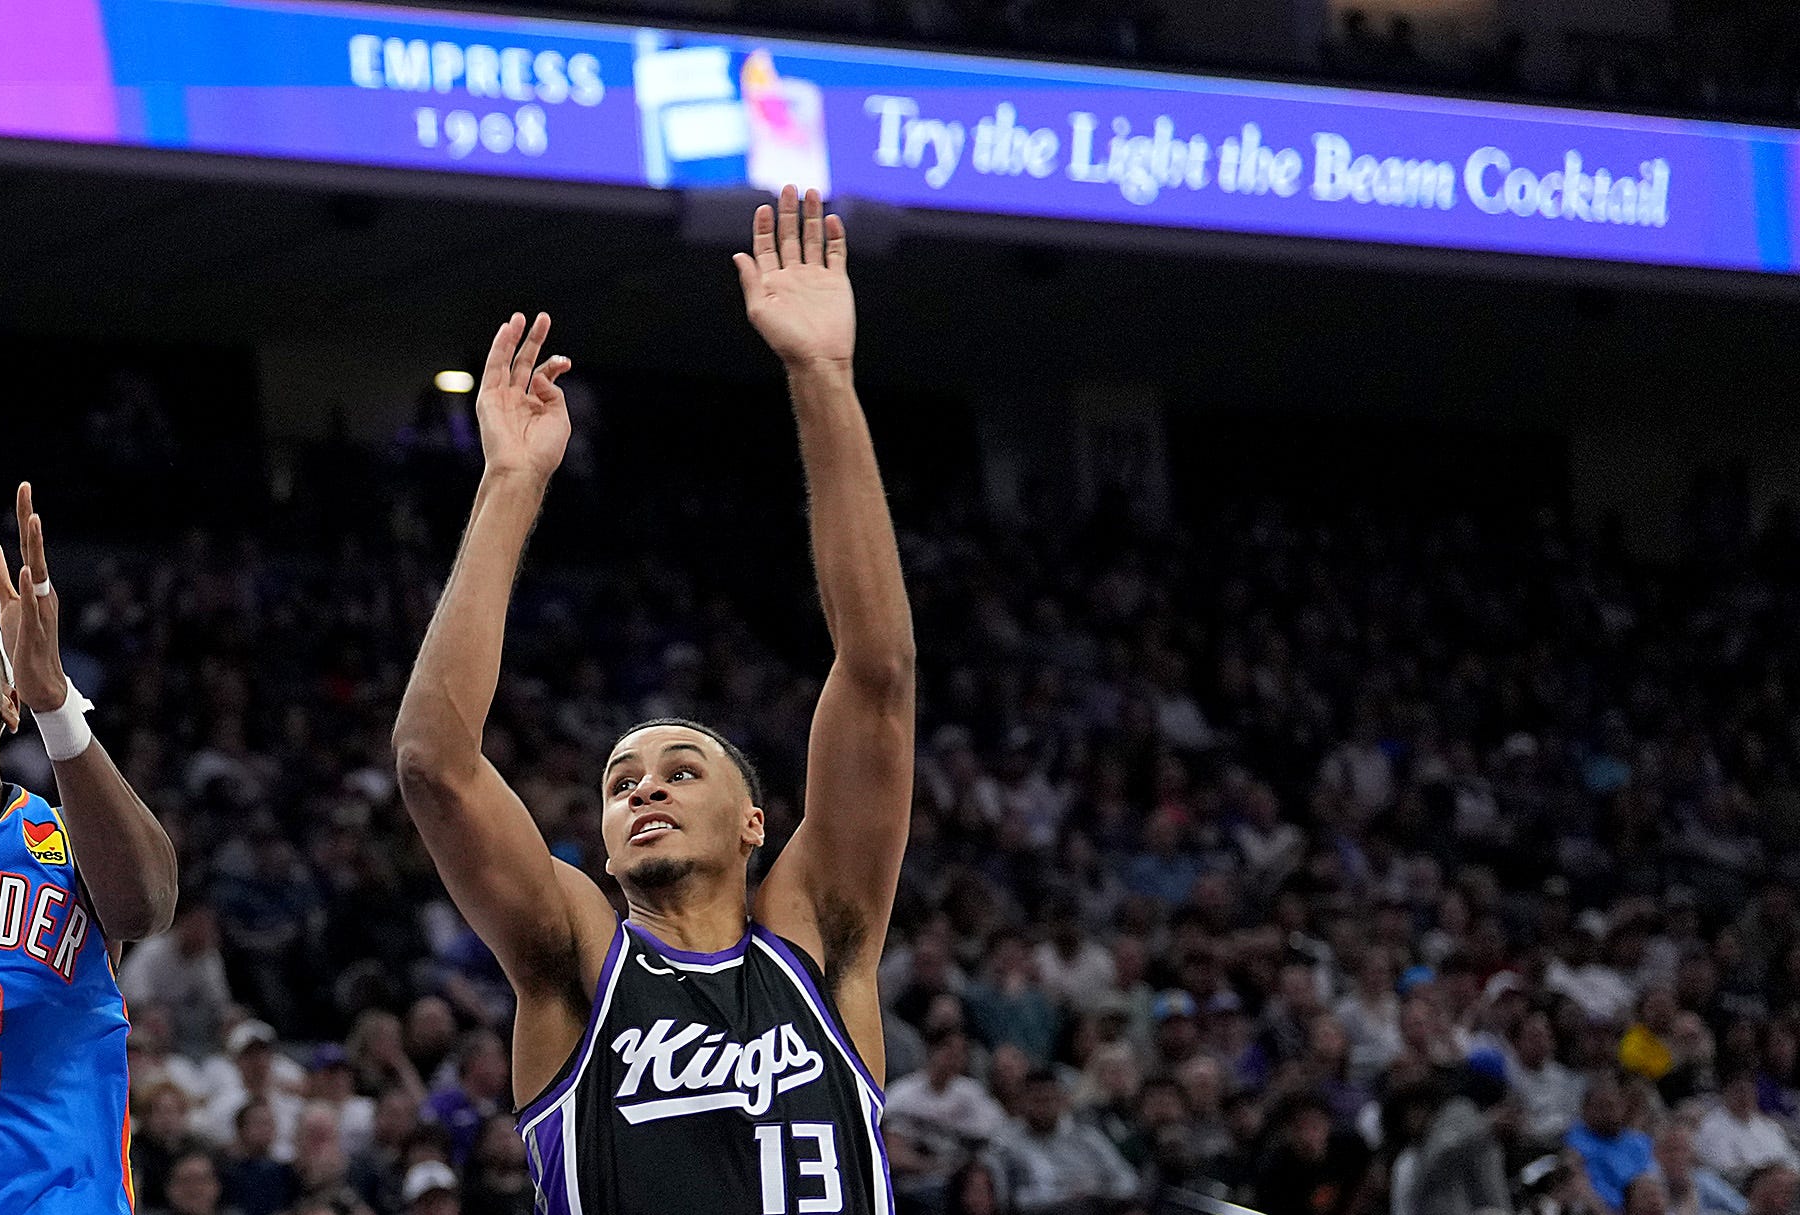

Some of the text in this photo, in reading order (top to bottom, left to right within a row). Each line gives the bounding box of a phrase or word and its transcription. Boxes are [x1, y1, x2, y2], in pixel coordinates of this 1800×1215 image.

[348, 33, 605, 106] EMPRESS
[415, 104, 548, 159] 1908
[864, 94, 1670, 228] Try the Light the Beam Cocktail
[611, 1018, 825, 1122] Kings
